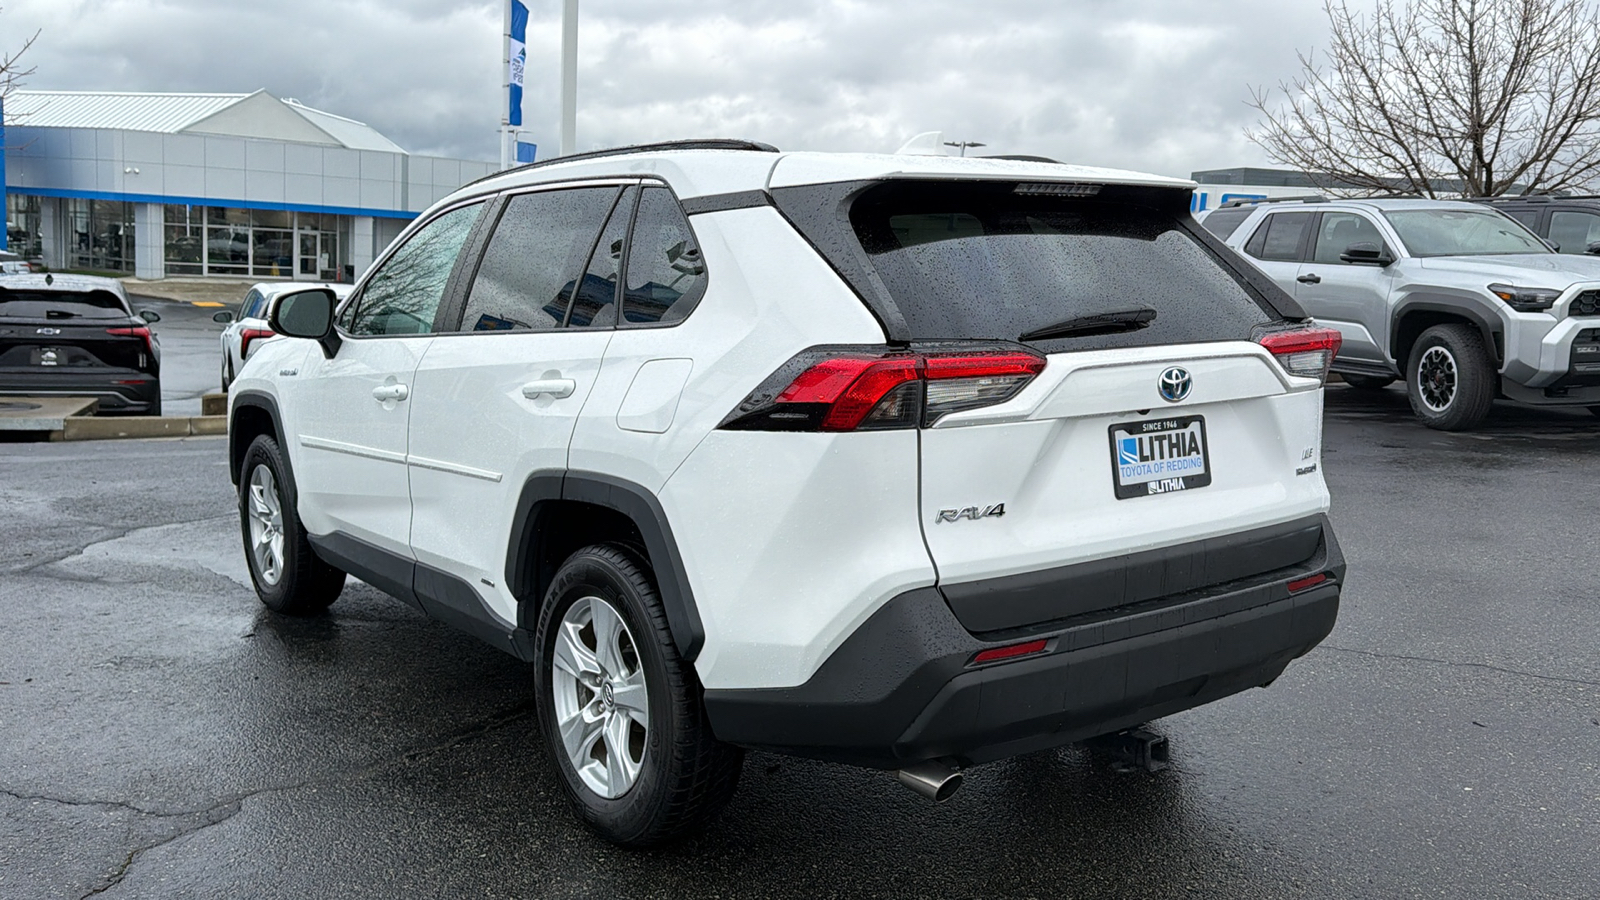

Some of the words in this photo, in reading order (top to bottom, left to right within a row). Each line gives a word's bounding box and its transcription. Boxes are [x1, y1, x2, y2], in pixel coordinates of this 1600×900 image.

[1142, 422, 1161, 432] SINCE
[1163, 421, 1177, 429] 1946
[1138, 431, 1200, 463] LITHIA
[1120, 464, 1152, 478] TOYOTA
[1155, 463, 1165, 473] OF
[1167, 457, 1202, 471] REDDING
[1156, 477, 1185, 493] LITHIA
[935, 501, 1006, 525] RAV4
